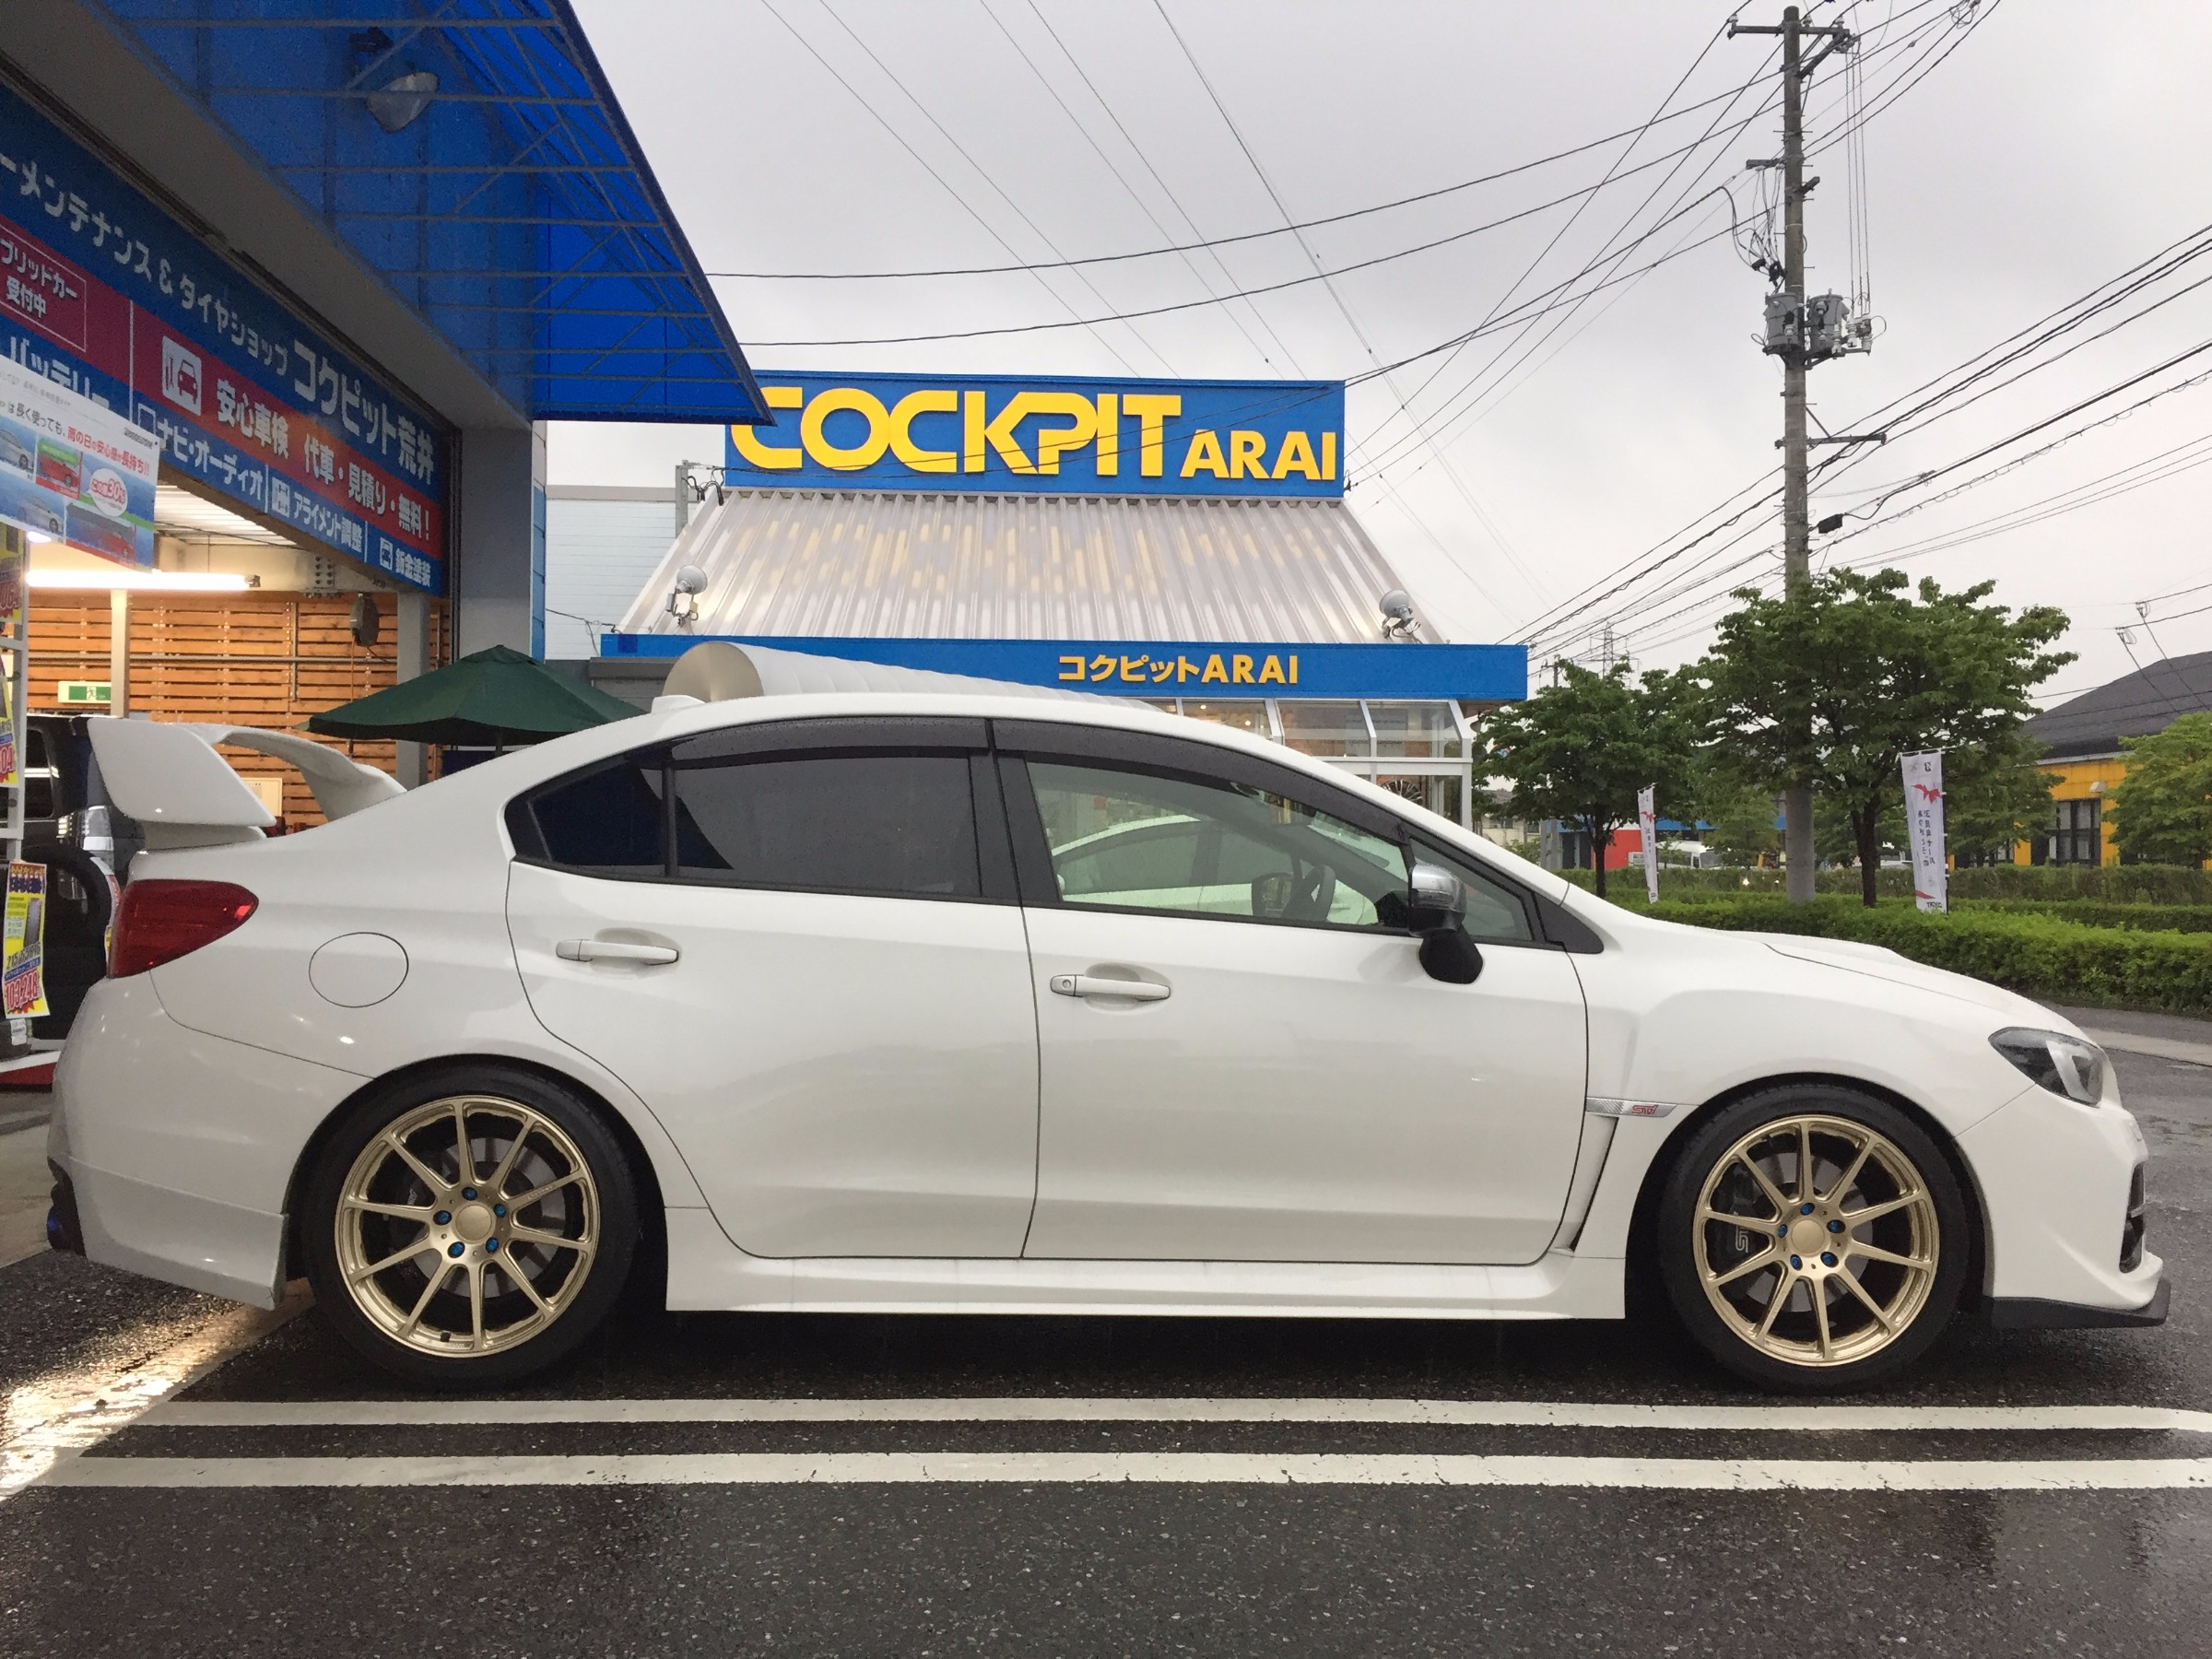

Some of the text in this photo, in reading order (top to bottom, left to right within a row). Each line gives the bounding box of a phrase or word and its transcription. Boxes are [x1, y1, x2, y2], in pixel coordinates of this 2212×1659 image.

[6, 275, 47, 319] 受付中
[180, 272, 288, 376] タイヤショップ
[294, 339, 434, 486] コクピット荒井
[217, 378, 289, 460] 安心車検
[729, 385, 1336, 481] COCKPIT ARAI
[293, 491, 363, 553] アライメント調整
